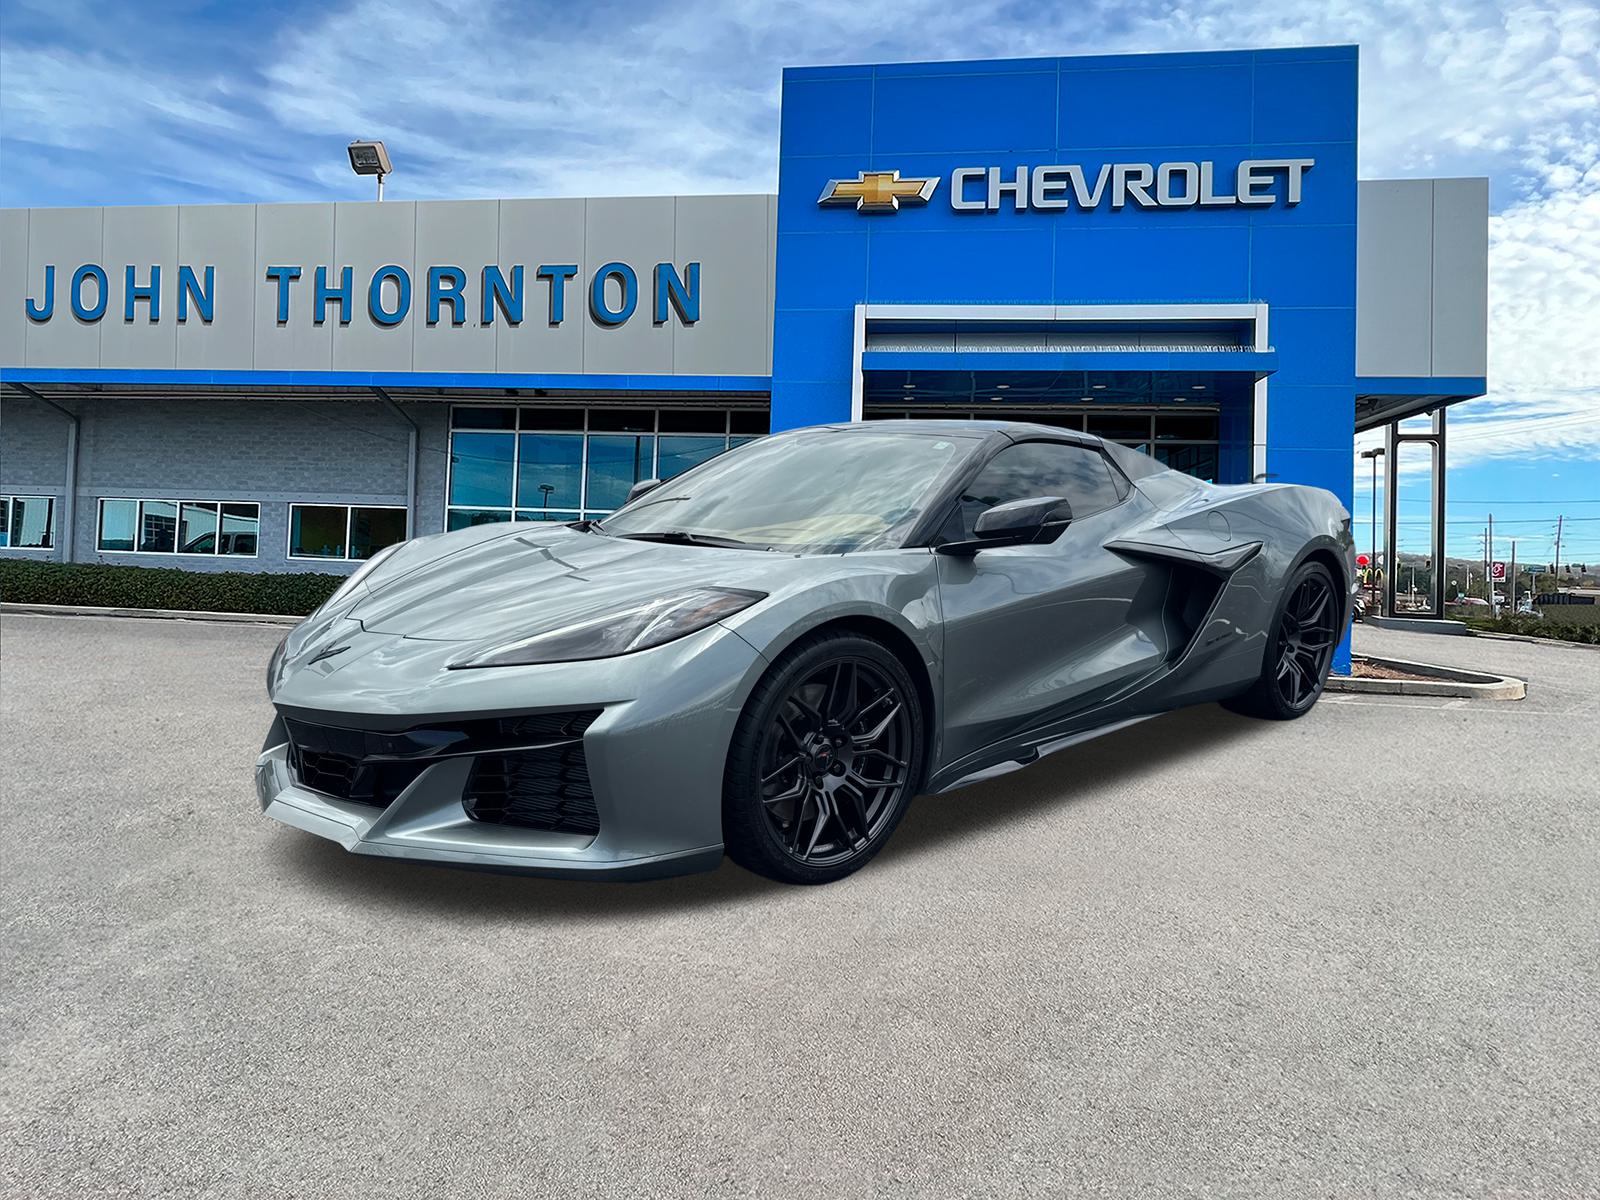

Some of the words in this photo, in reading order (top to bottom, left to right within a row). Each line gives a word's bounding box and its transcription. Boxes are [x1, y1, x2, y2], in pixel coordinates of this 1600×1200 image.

[951, 158, 1315, 210] CHEVROLET
[25, 264, 215, 324] JOHN
[266, 262, 701, 328] THORNTON
